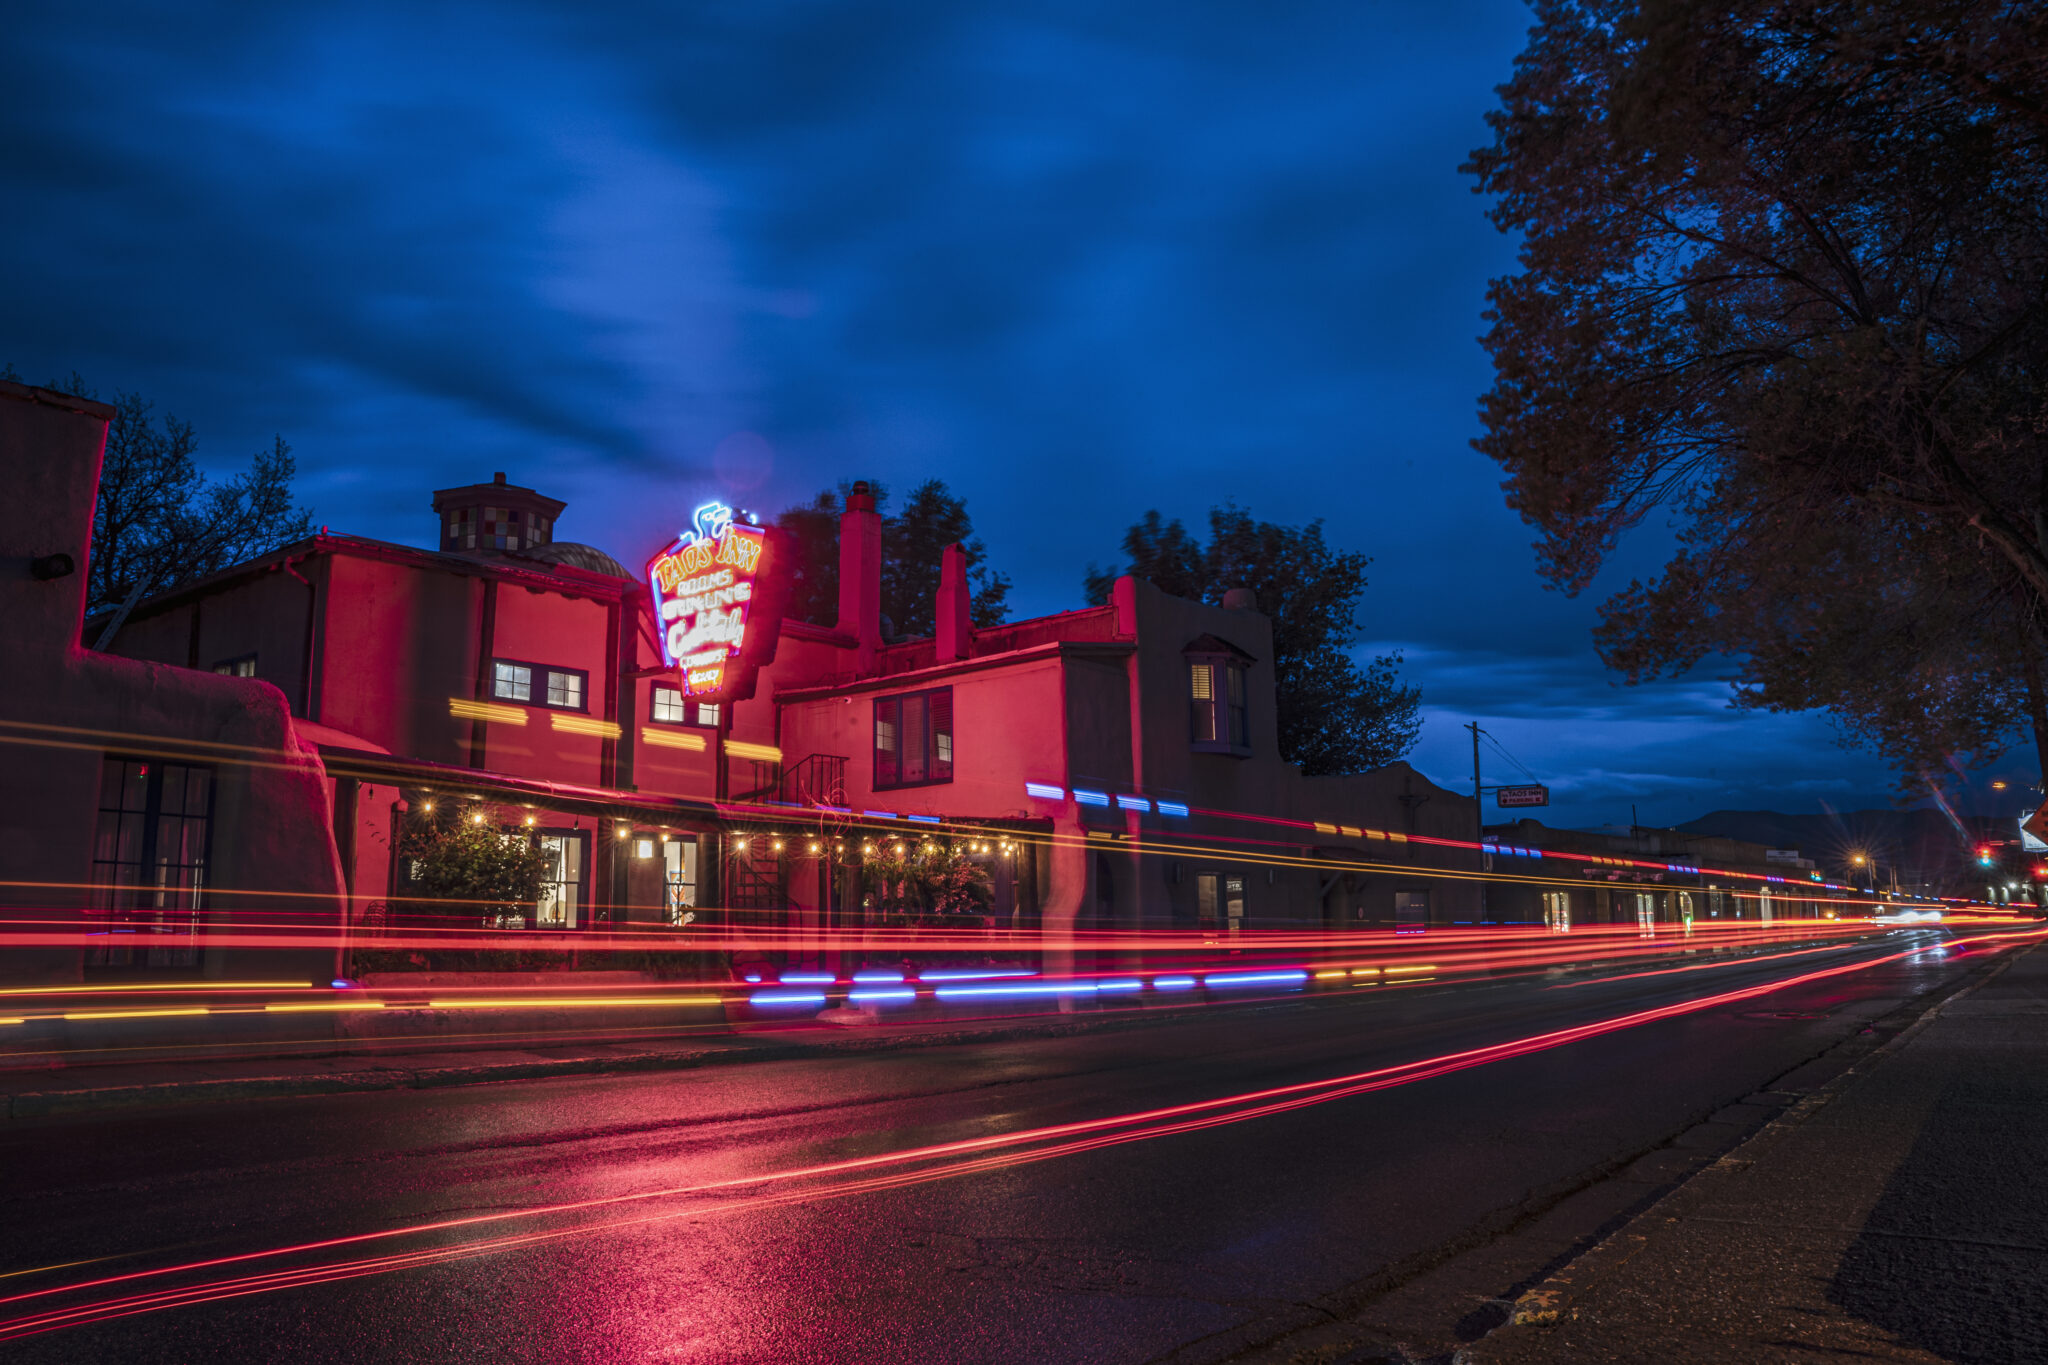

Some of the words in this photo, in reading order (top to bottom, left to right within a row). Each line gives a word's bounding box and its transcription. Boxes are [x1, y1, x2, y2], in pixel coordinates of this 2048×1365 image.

[653, 540, 713, 593] TAOS
[677, 569, 733, 596] ROOMS
[1508, 790, 1527, 798] TAOS
